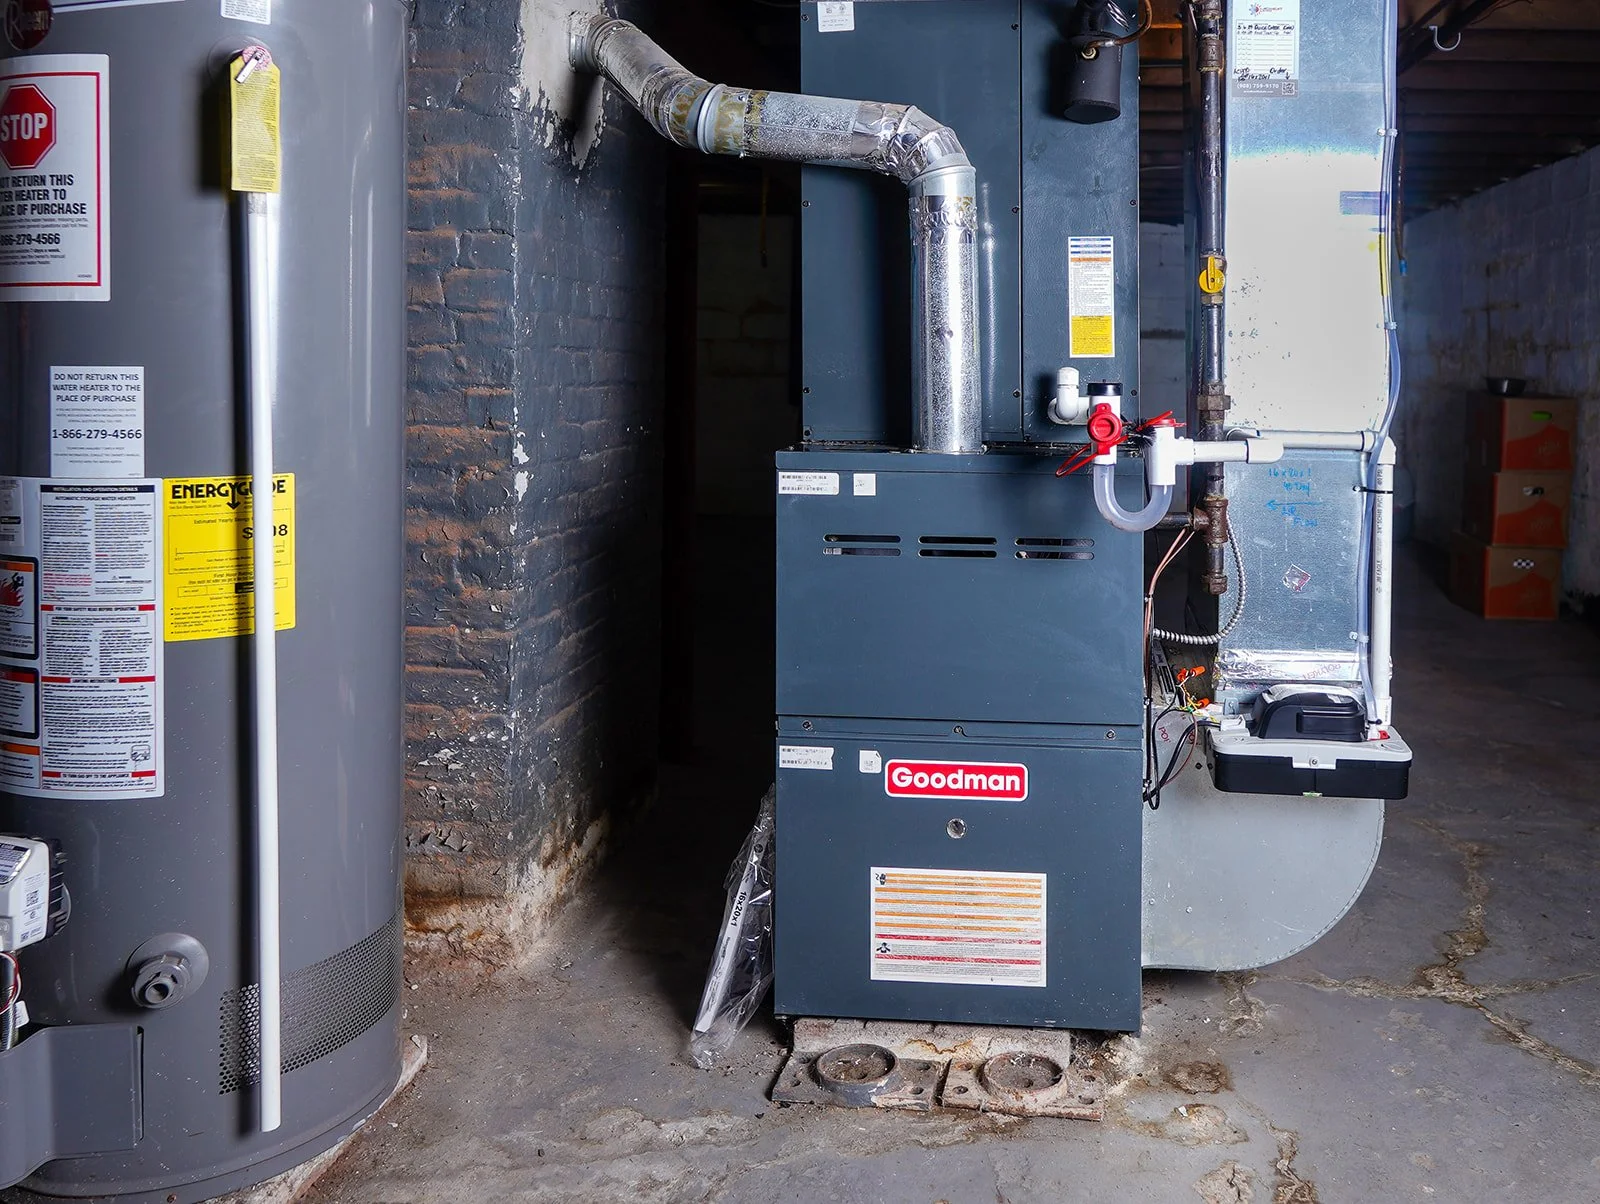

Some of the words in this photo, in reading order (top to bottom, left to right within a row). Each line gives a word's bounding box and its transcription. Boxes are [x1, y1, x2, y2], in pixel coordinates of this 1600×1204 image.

[0, 112, 49, 142] STOP
[12, 174, 46, 187] RETURN
[49, 174, 74, 186] THIS
[15, 188, 50, 202] HEATER
[53, 188, 67, 201] TO
[17, 204, 28, 216] OF
[30, 202, 87, 215] PURCHASE
[54, 373, 66, 381] DO
[67, 373, 84, 381] NOT
[85, 373, 118, 381] RETURN
[120, 373, 139, 381] THIS
[125, 384, 141, 392] THE
[52, 429, 142, 439] 1-866-279-4566
[171, 479, 287, 500] ENERGYGE
[242, 523, 288, 540] $8
[892, 766, 1021, 792] Goodman
[730, 891, 747, 927] 16x20x1
